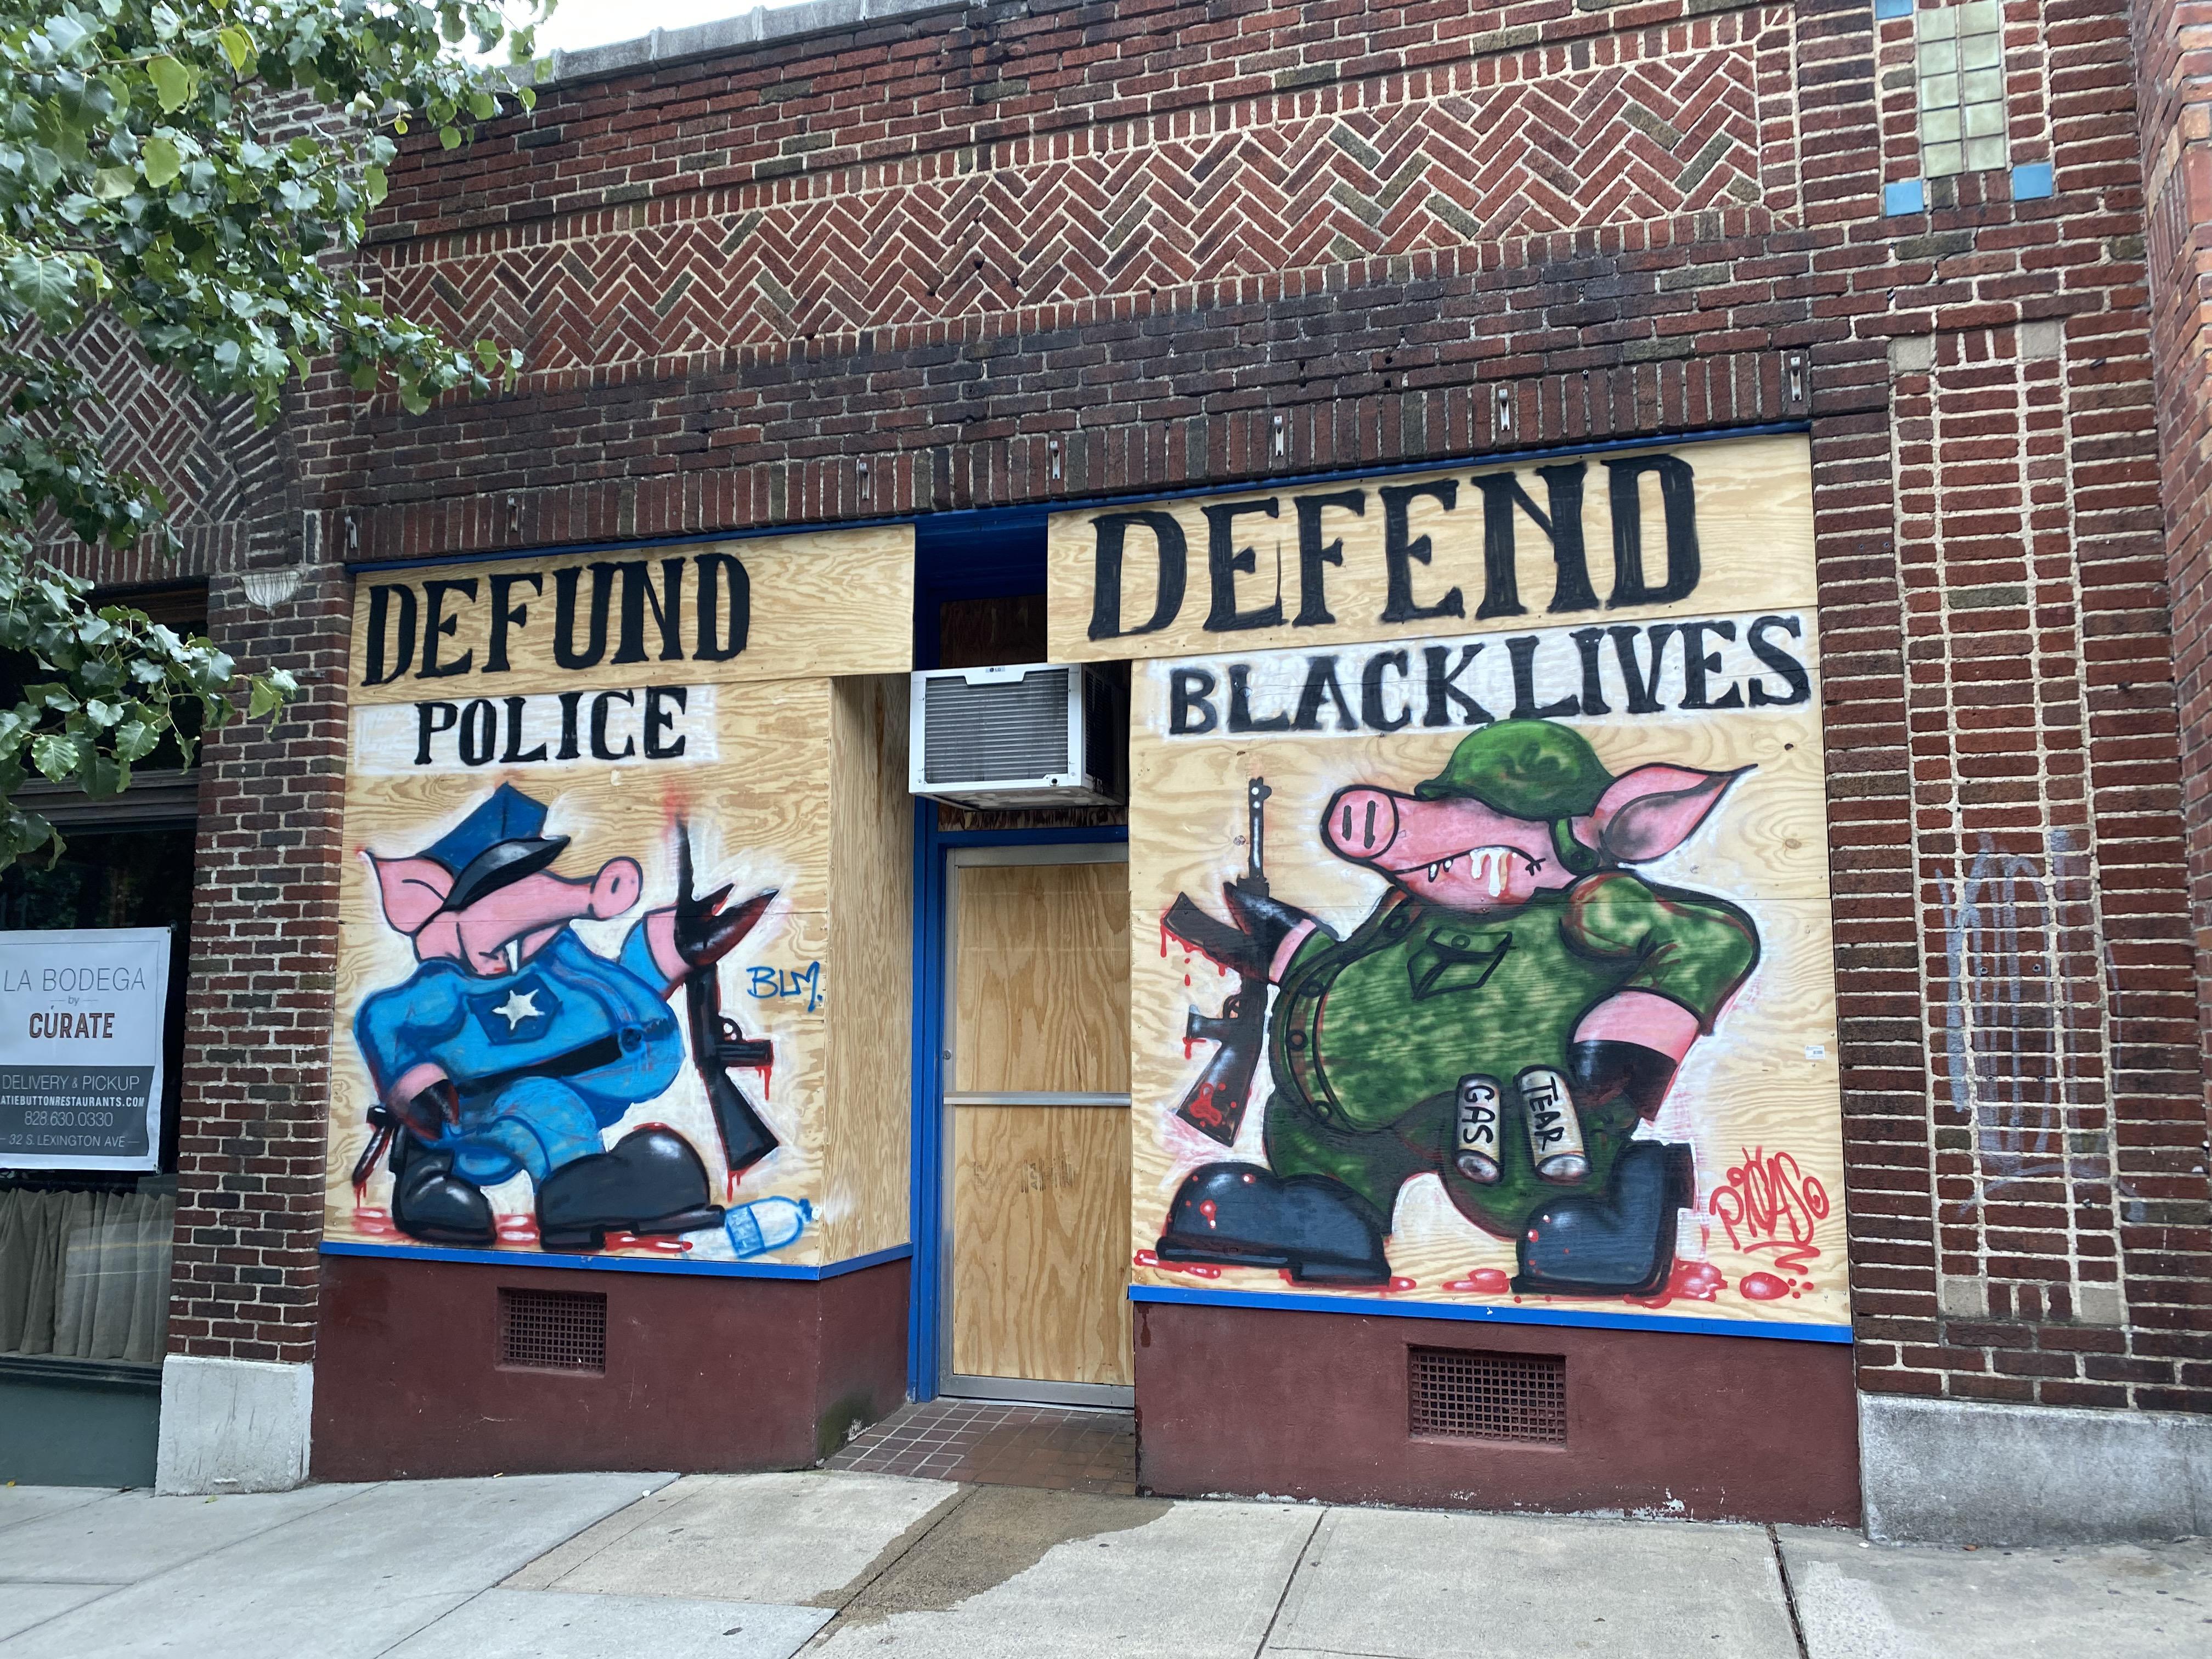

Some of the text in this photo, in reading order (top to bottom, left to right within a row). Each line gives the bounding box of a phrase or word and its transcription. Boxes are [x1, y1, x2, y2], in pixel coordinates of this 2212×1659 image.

[1087, 453, 1703, 642] DEFEND
[360, 553, 751, 687] DEFUND
[1170, 616, 1812, 735] BLACK LIVES
[413, 685, 689, 766] POLICE
[4, 967, 146, 992] LA BODEGA
[67, 995, 80, 1006] by
[0, 1095, 145, 1107] ATIEBUTTONRESTAURANTS.COM
[2, 1074, 140, 1091] DELIVERY & PICKUP
[24, 1110, 114, 1127] 828.630.0330
[1462, 1085, 1496, 1144] GAS
[1521, 1076, 1565, 1152] TEAR
[9, 1134, 126, 1148] 32 S. LEXINGTON AVE
